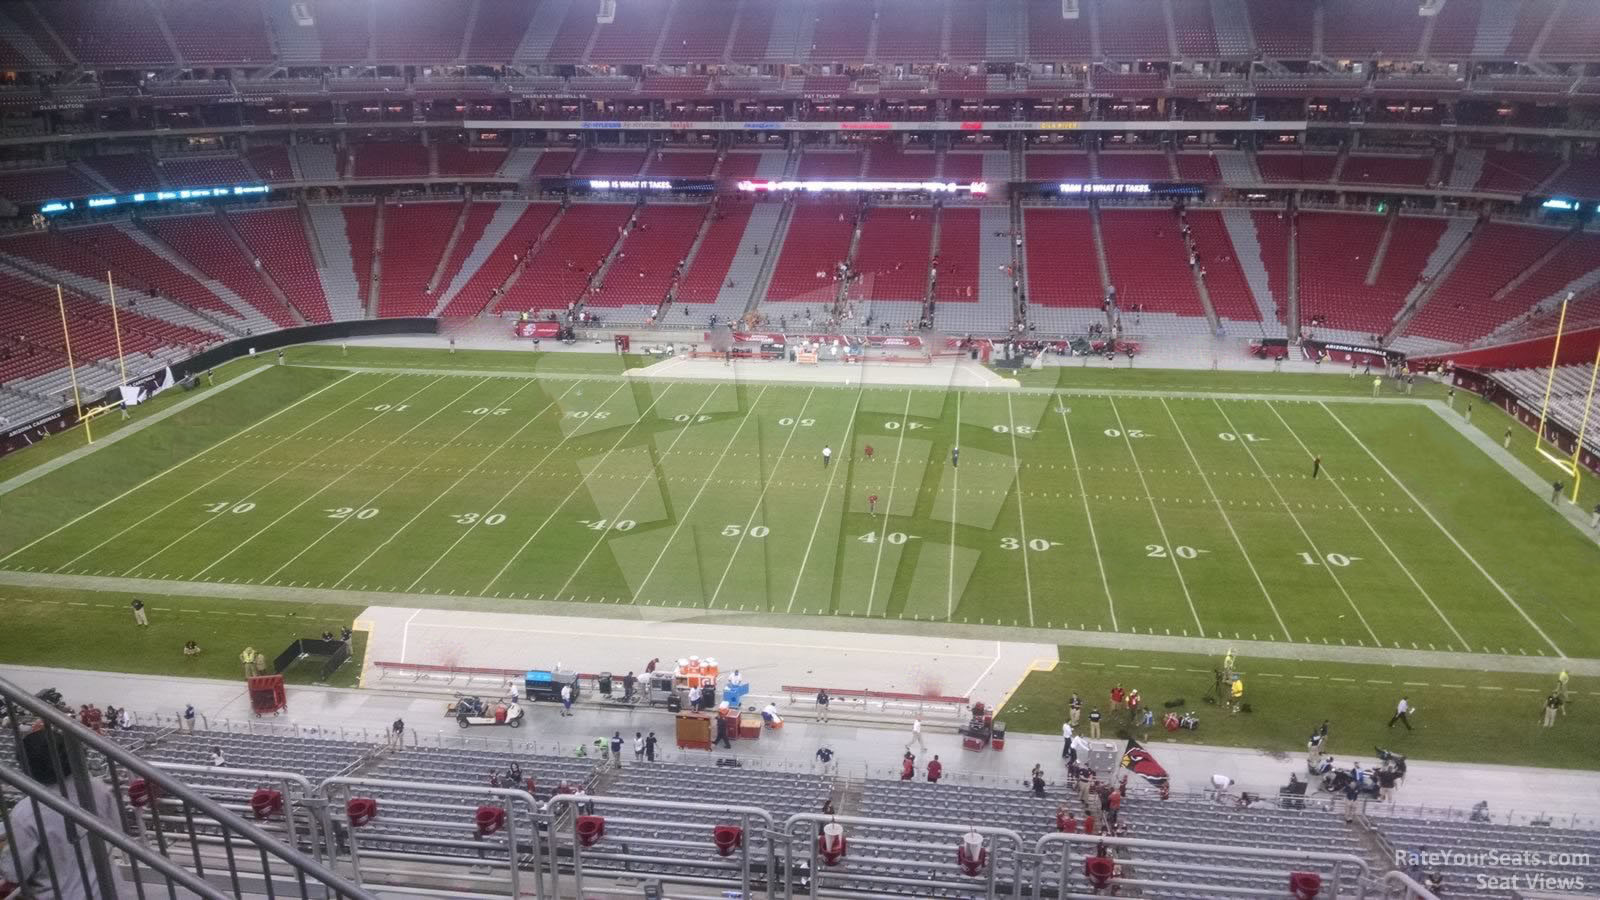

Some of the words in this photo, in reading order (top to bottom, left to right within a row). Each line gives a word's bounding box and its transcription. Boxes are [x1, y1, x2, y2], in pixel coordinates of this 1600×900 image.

[611, 180, 619, 188] IS
[619, 180, 640, 188] WHAT
[640, 180, 647, 188] IT
[1083, 184, 1092, 192] IS
[1092, 184, 1116, 192] WHAT
[1116, 184, 1124, 192] IT
[1325, 343, 1353, 352] ARIZONA
[1353, 347, 1387, 357] CARDINALS
[778, 417, 816, 427] 50
[204, 502, 256, 514] 10
[327, 507, 379, 520] 20
[456, 512, 506, 526] 30
[586, 519, 637, 532] 40
[720, 525, 770, 538] 50
[857, 531, 908, 545] 40
[1000, 537, 1050, 551] 30
[1145, 544, 1198, 559] 20
[1296, 552, 1350, 567] 10
